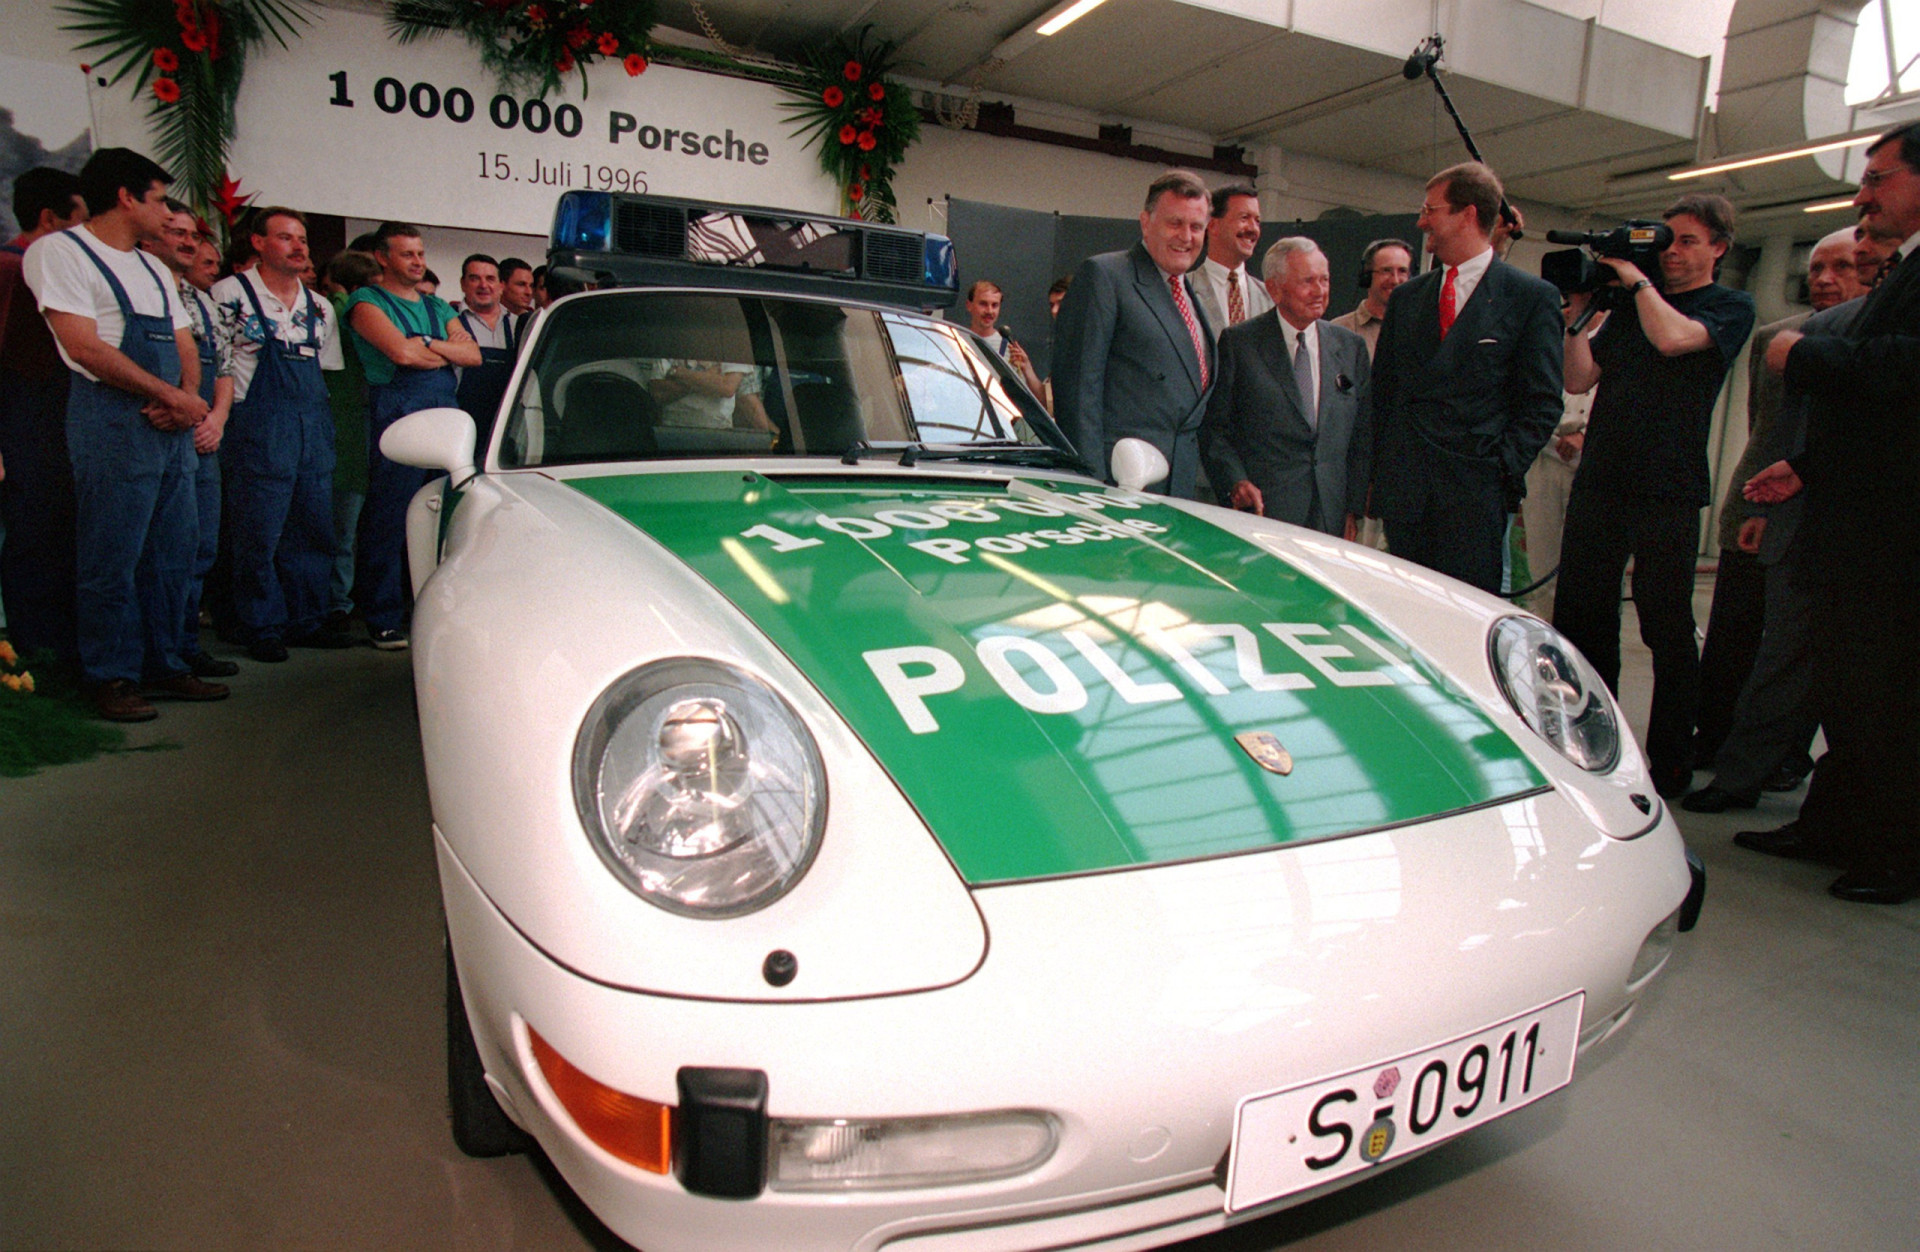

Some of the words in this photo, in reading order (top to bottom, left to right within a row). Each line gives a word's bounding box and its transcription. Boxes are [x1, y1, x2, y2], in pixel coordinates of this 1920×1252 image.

[329, 70, 354, 108] 1
[374, 77, 474, 123] 000
[489, 94, 583, 138] 000
[609, 110, 769, 166] Porsche
[478, 152, 519, 182] 15.
[528, 158, 571, 187] Juli
[582, 164, 648, 194] 1996
[740, 524, 824, 552] 1
[815, 504, 1000, 539] 000
[908, 518, 1168, 564] Porsche
[861, 623, 1430, 734] POLIZEI
